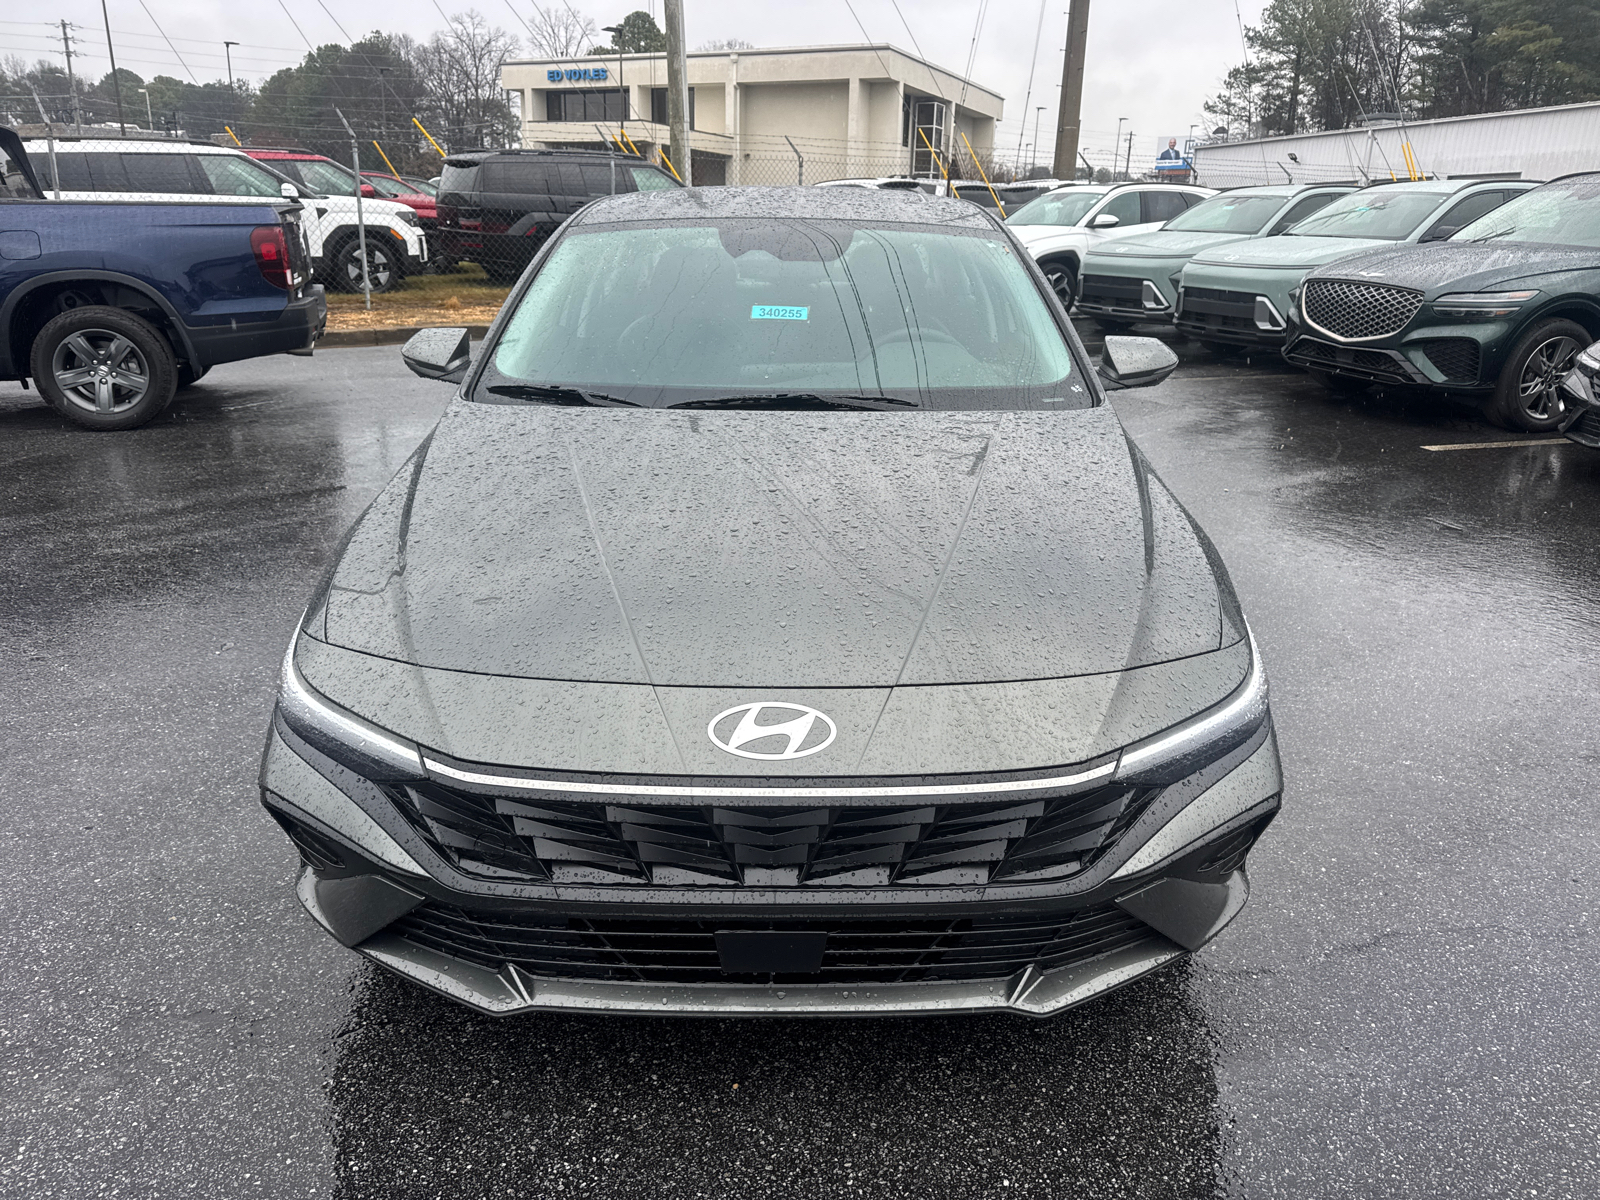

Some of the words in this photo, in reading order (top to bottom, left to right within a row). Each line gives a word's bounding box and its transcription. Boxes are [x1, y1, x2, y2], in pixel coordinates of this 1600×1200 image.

[547, 70, 563, 81] ED
[564, 68, 608, 81] VOYLES
[759, 308, 802, 318] 340255
